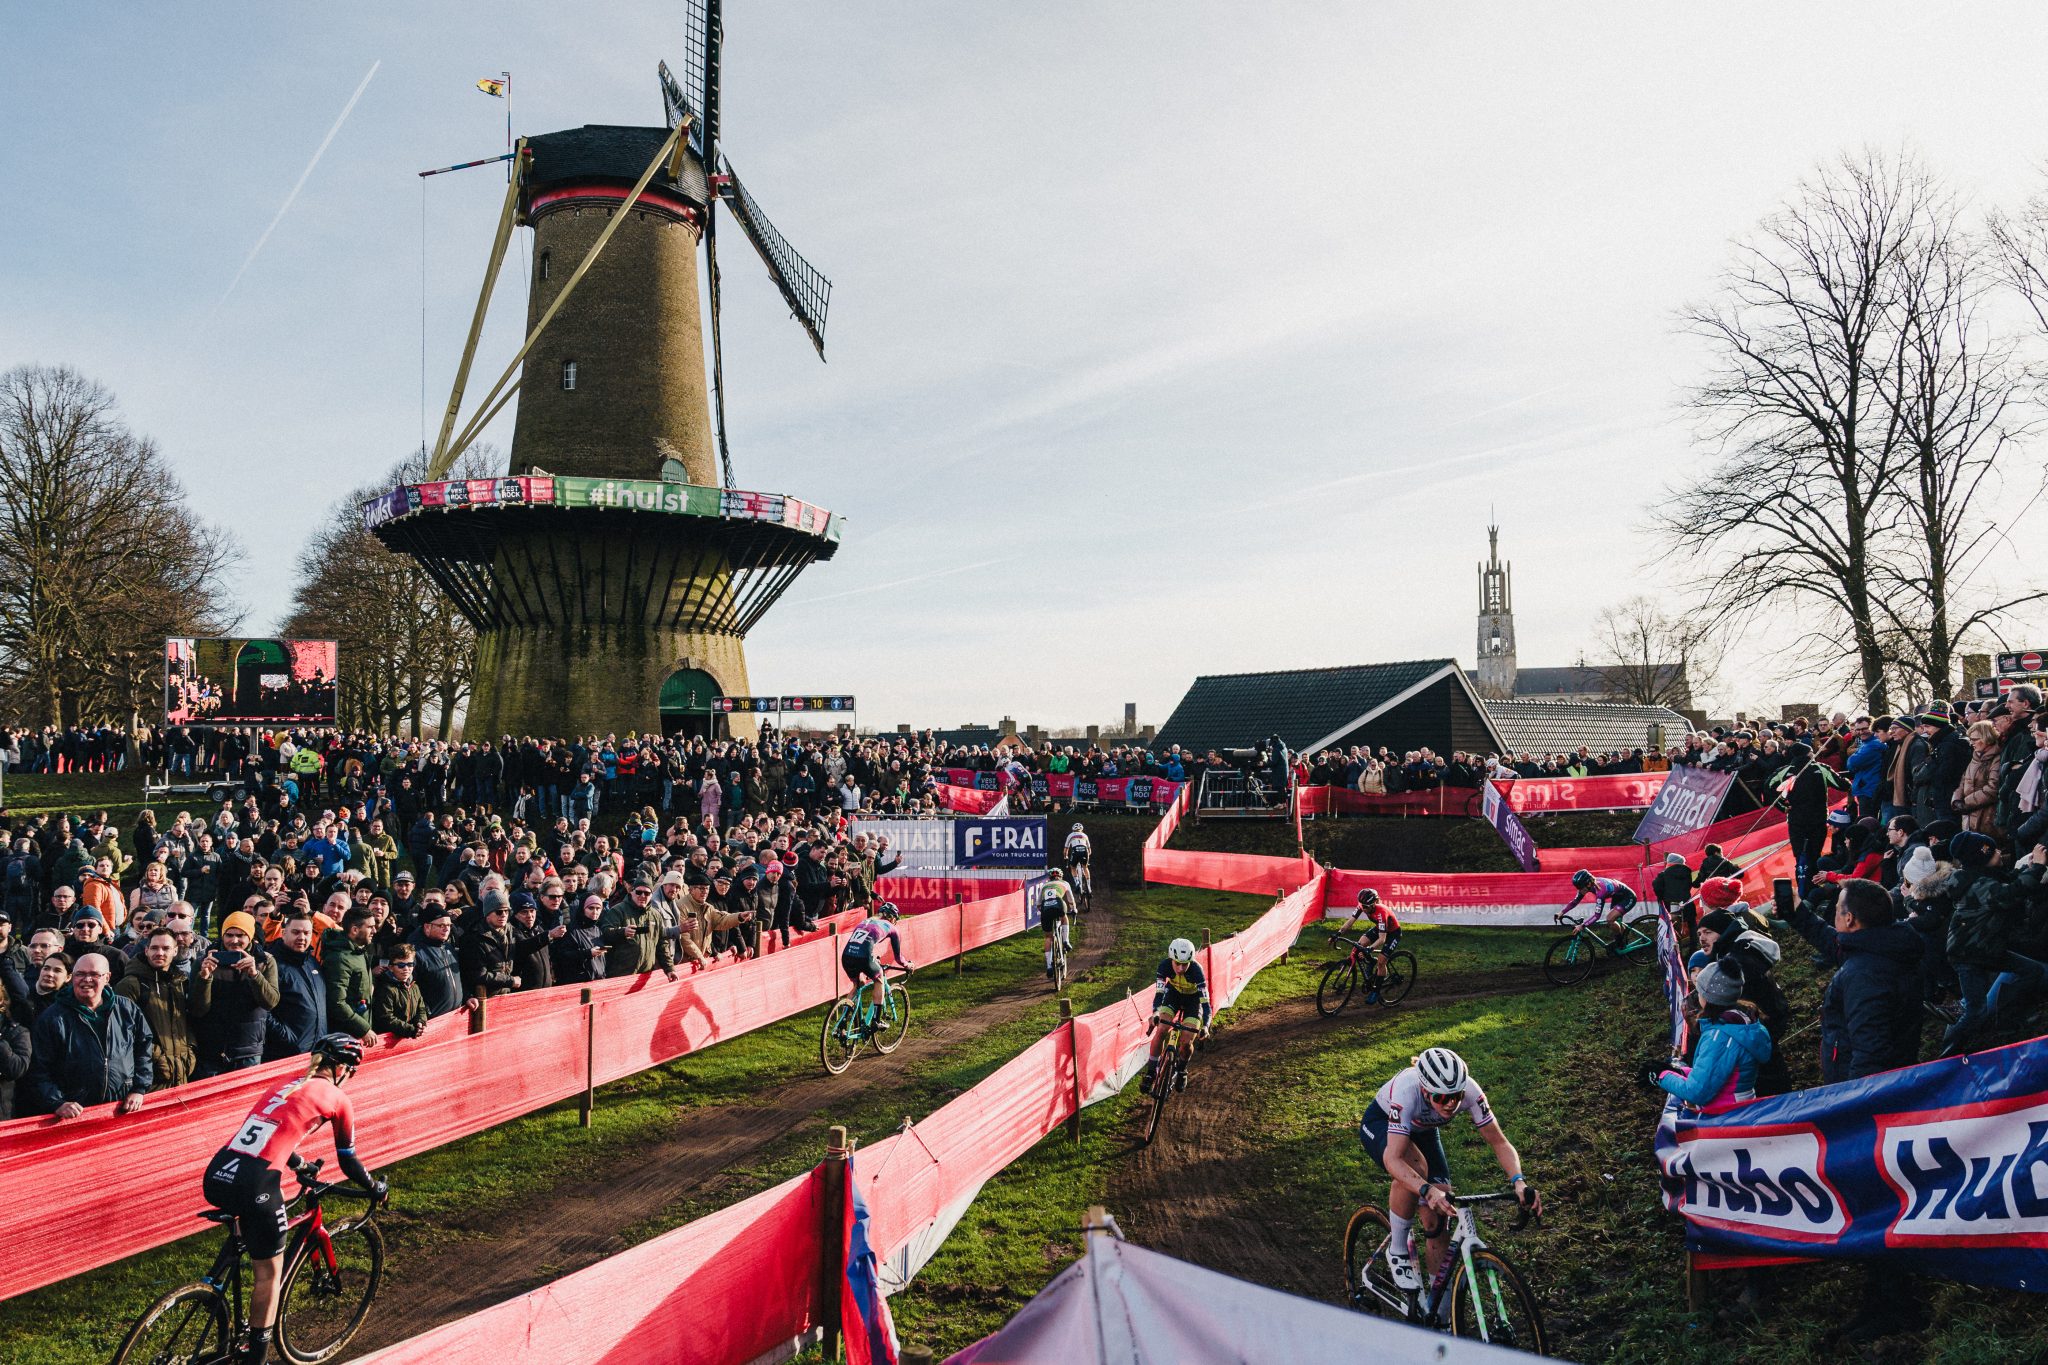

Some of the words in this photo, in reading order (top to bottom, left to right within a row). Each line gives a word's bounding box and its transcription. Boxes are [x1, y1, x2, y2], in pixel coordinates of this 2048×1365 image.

[501, 490, 520, 498] ROCK
[588, 481, 689, 513] #ihulst
[740, 700, 749, 709] 10
[811, 700, 822, 708] 10
[1654, 776, 1717, 828] simac
[992, 827, 1043, 849] FRAI
[1505, 814, 1525, 856] simac
[854, 931, 866, 939] 17
[240, 1125, 263, 1145] 5
[215, 1170, 235, 1180] ALPHA
[1897, 1120, 2048, 1222] Hub
